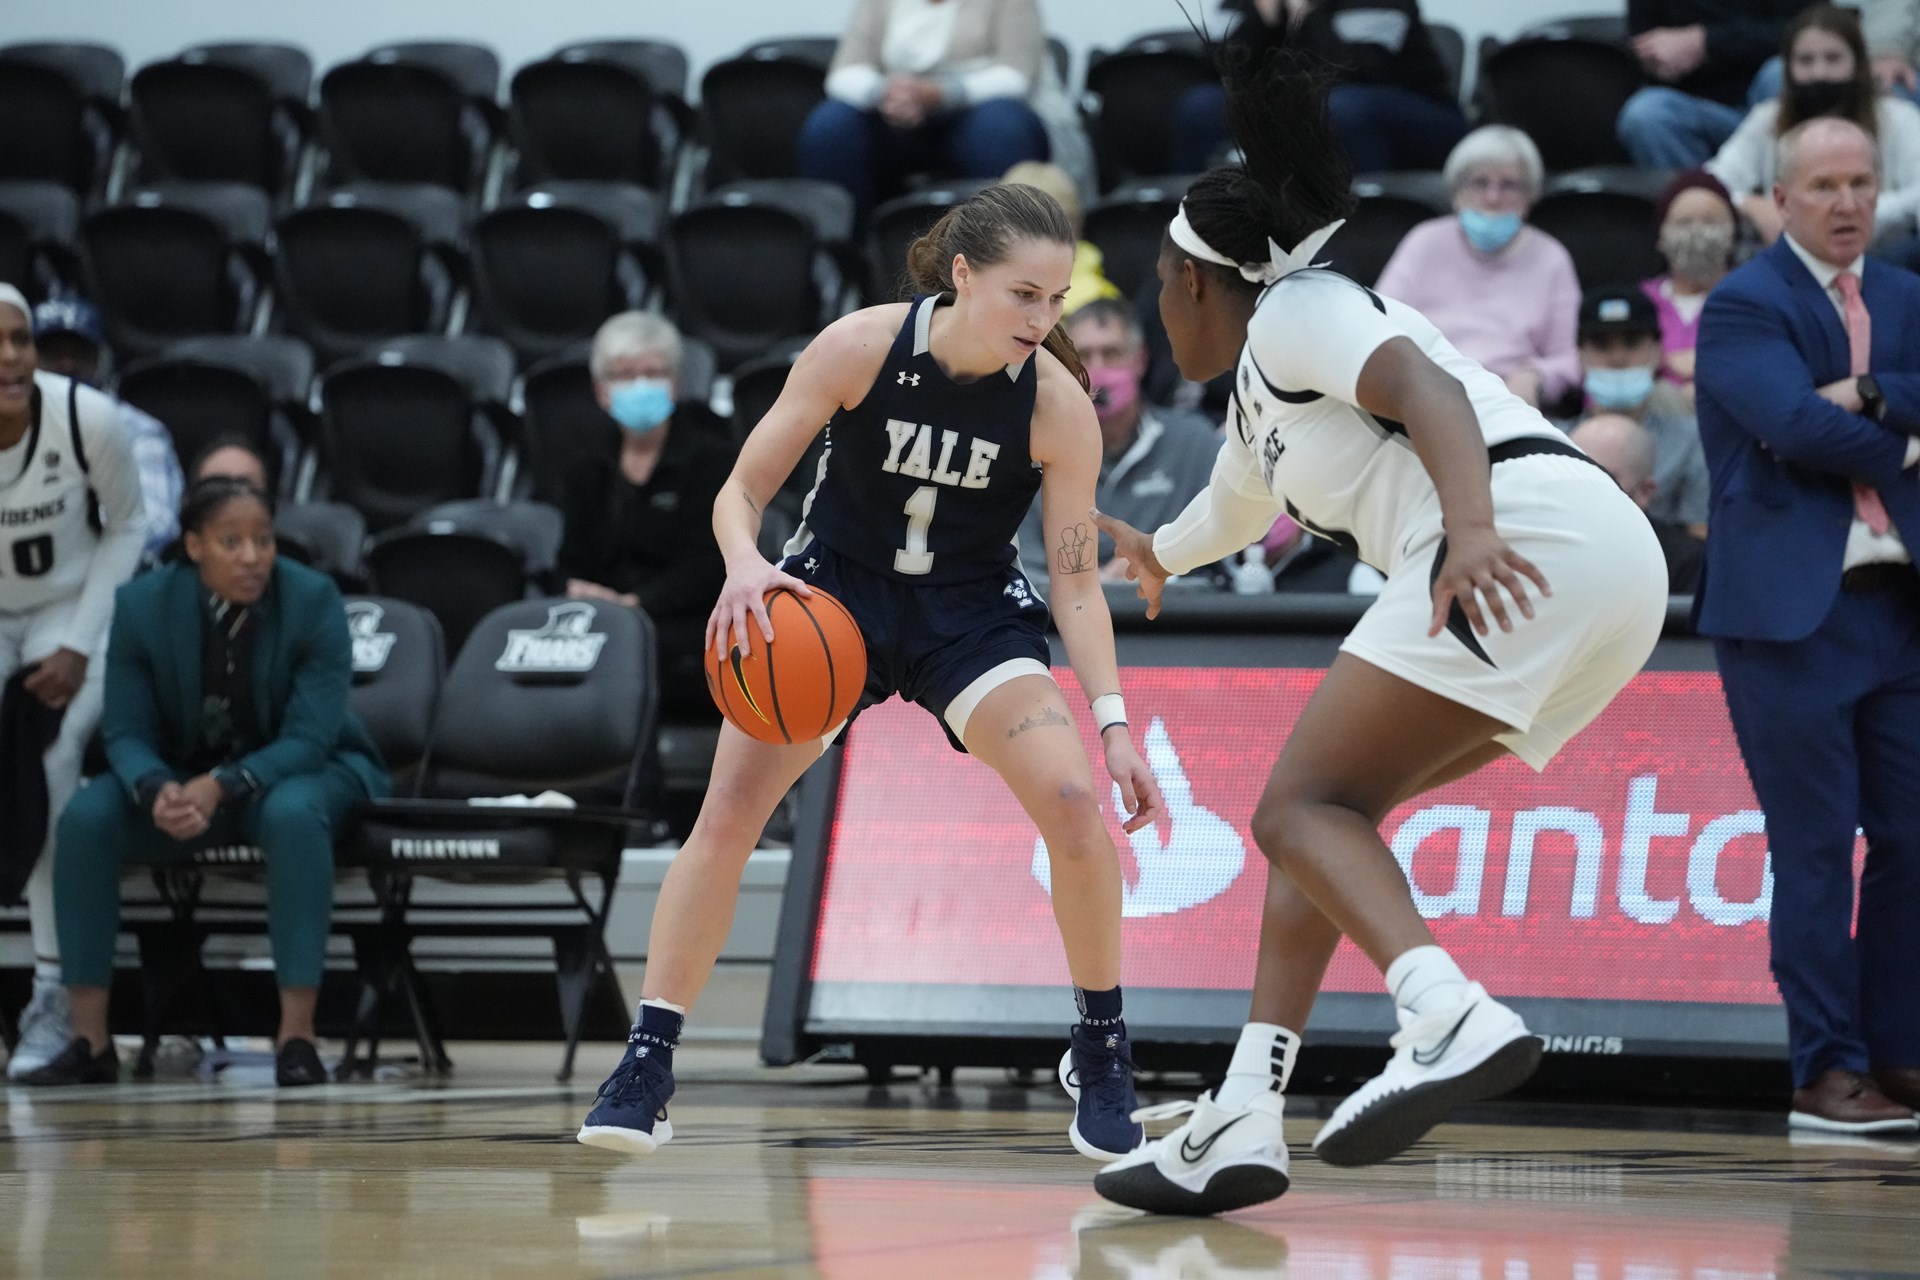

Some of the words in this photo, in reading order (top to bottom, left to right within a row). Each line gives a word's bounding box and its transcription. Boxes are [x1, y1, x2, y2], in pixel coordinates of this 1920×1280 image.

[882, 418, 1000, 489] YALE
[893, 486, 938, 575] 1
[1392, 773, 1774, 926] anta
